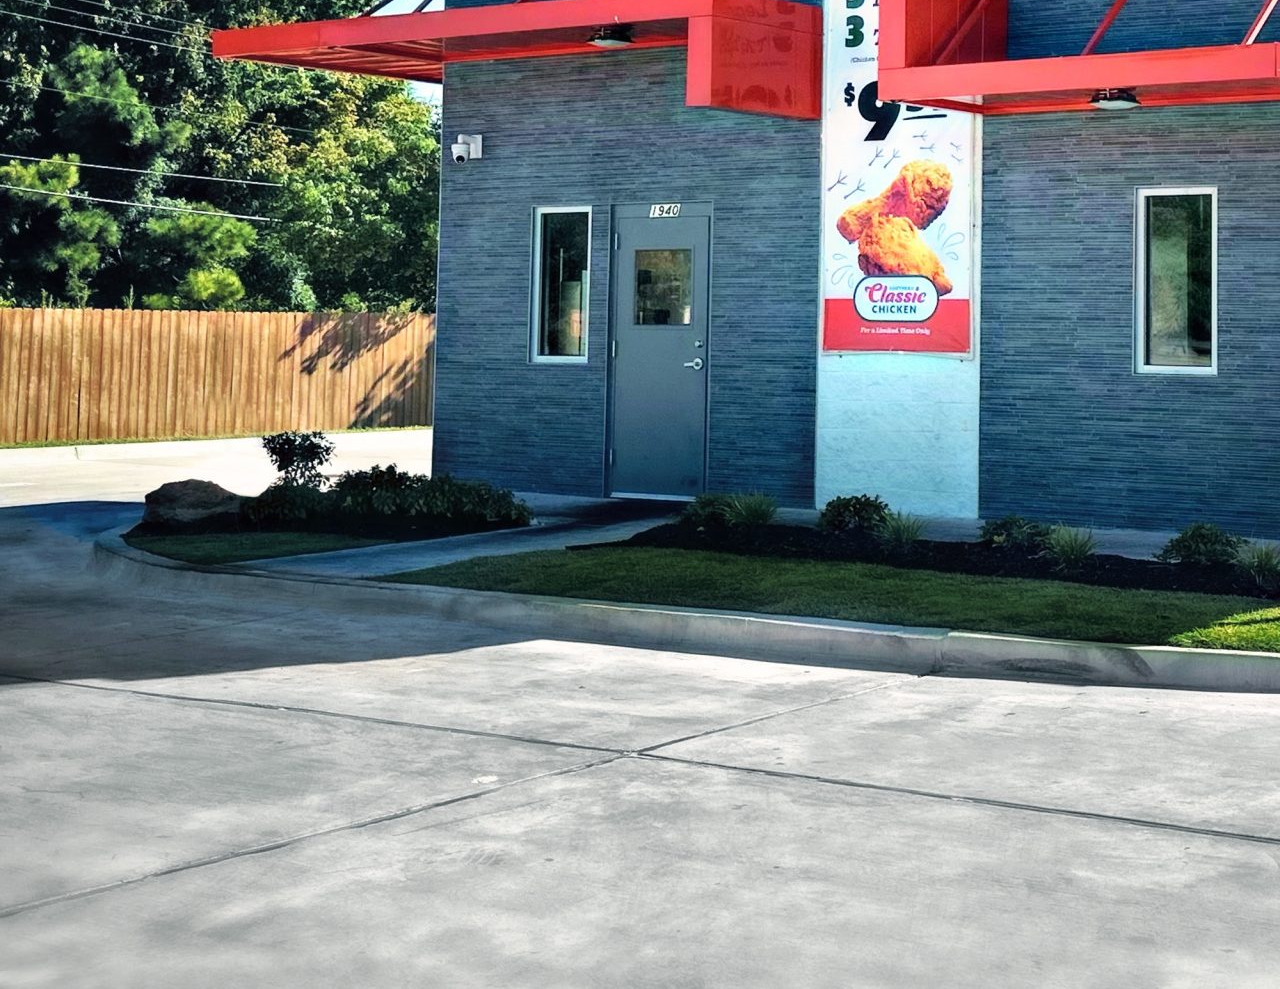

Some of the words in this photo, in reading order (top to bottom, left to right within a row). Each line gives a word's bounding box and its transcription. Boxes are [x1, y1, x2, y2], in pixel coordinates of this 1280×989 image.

[844, 14, 865, 48] 3
[844, 80, 941, 142] $9
[652, 205, 679, 216] 1940
[864, 282, 927, 303] Classic
[872, 305, 917, 314] CHICKEN
